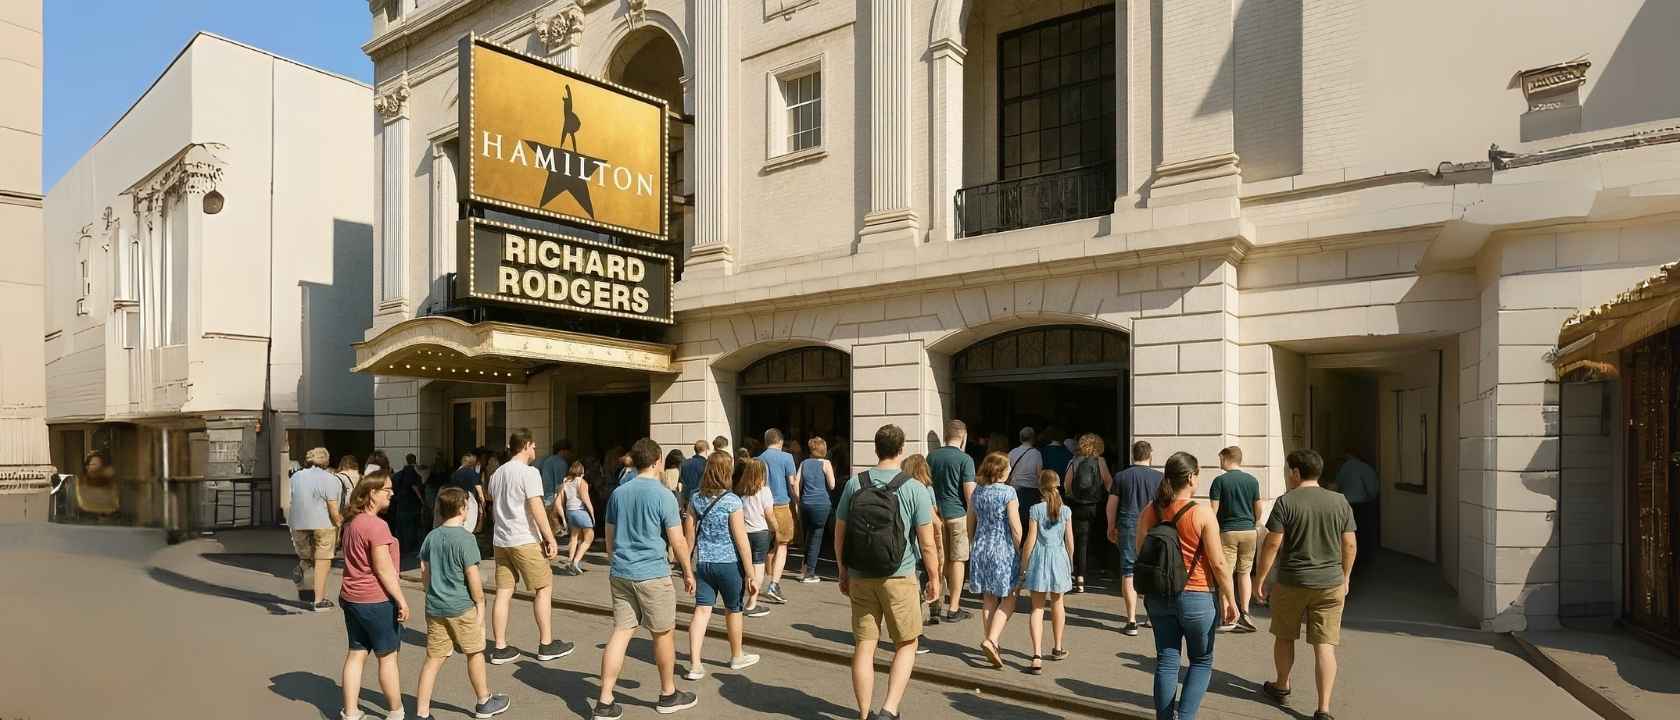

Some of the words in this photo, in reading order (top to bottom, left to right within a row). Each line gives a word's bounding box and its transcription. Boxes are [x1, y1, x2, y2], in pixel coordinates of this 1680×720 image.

[482, 130, 653, 196] HAMILTON
[504, 233, 646, 283] RICHARD
[499, 266, 650, 314] RODGERS
